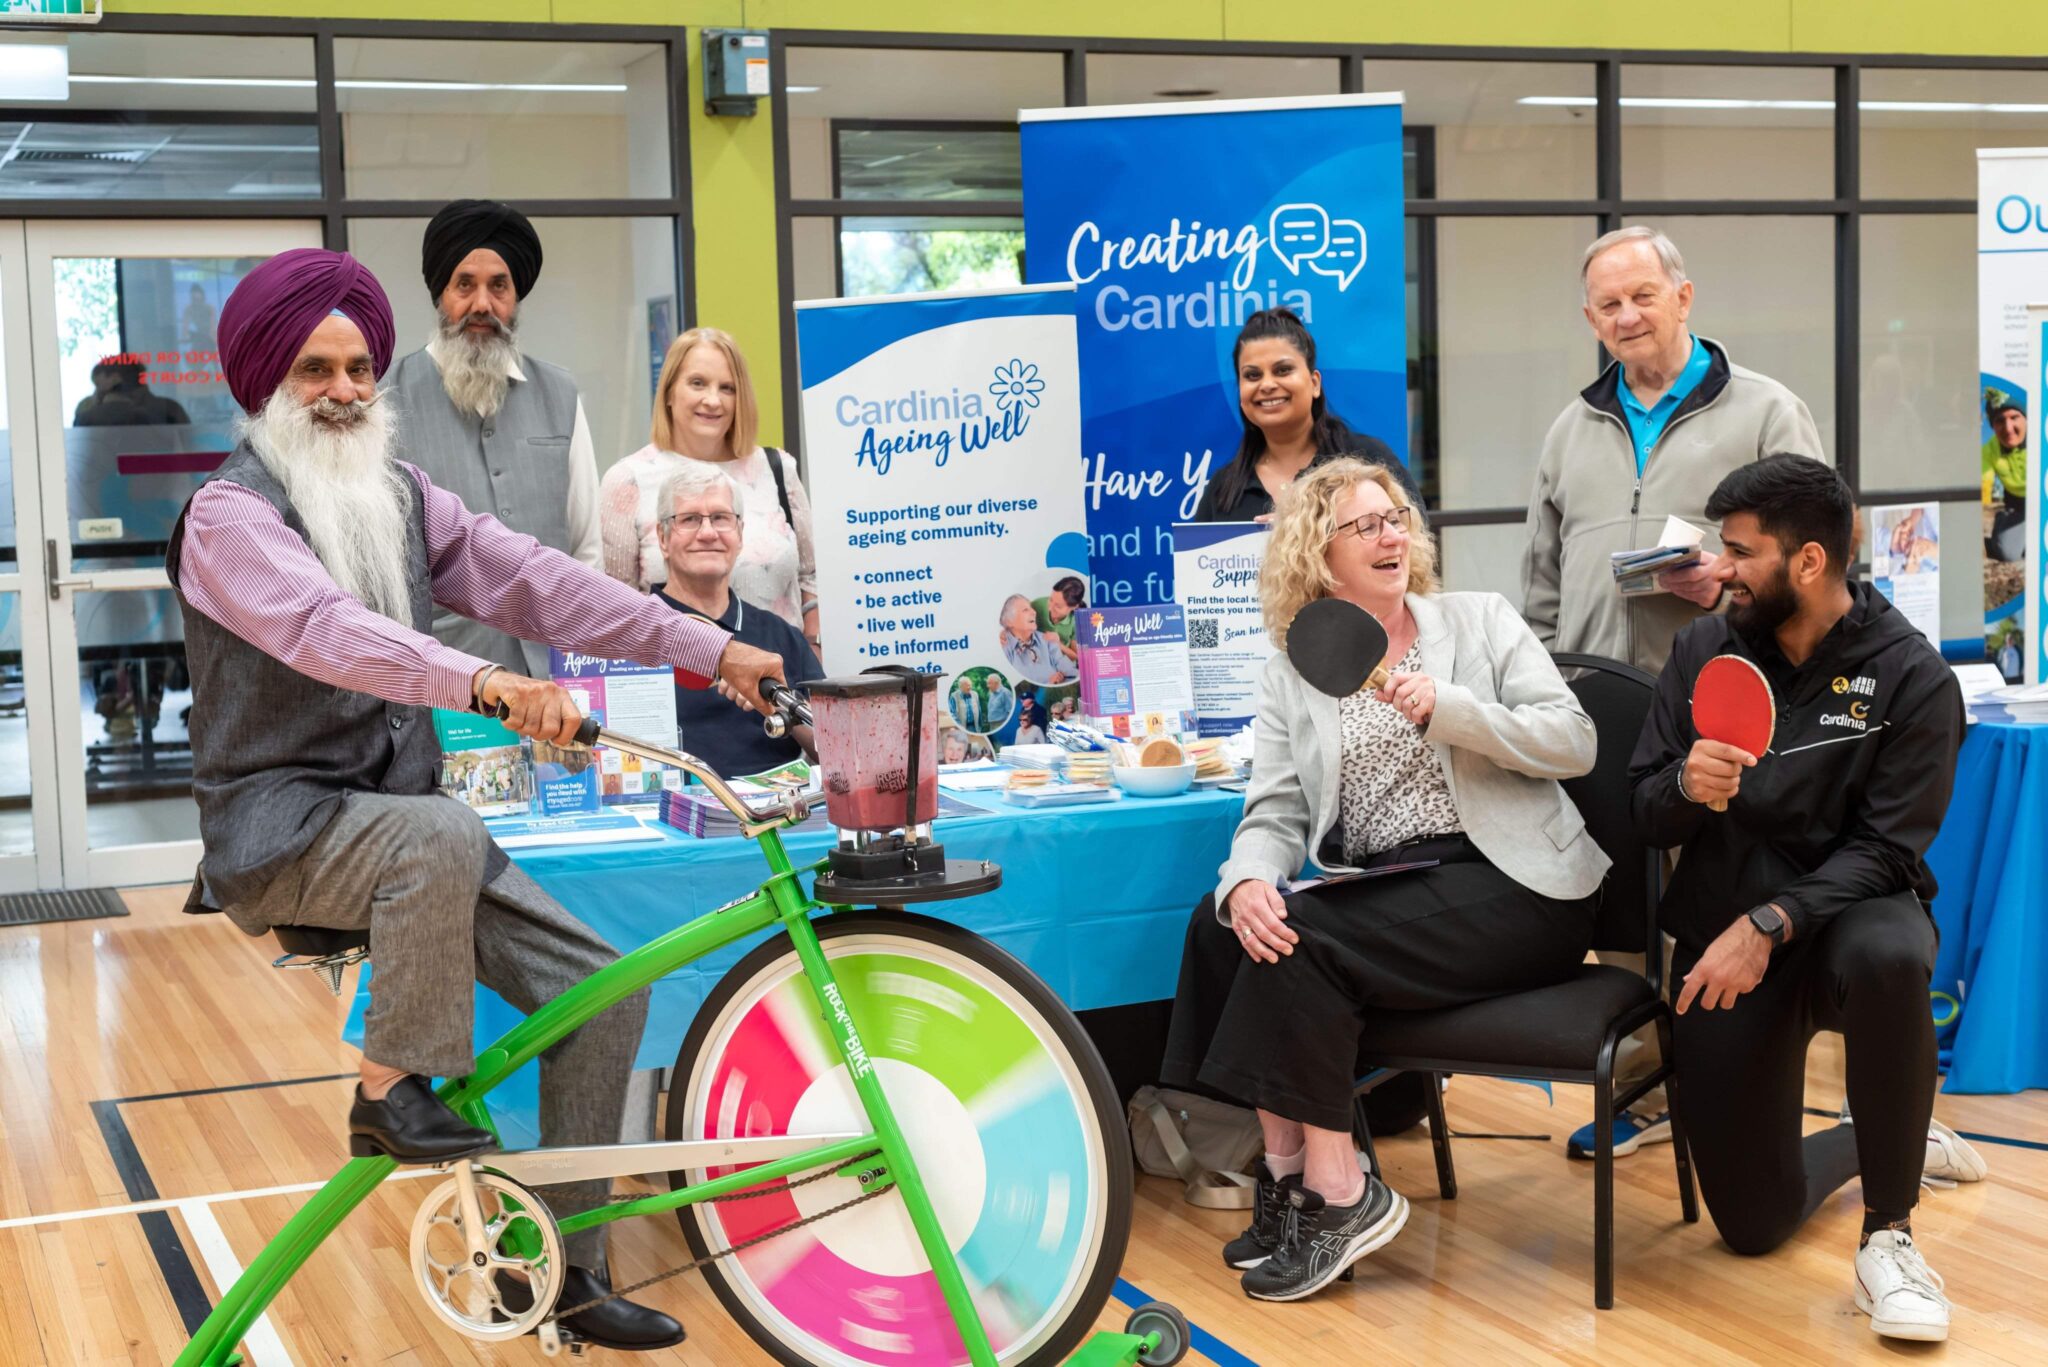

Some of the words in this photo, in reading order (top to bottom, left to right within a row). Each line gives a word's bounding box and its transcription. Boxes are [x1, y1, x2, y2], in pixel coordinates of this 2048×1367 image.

[1066, 217, 1268, 291] Creating
[835, 388, 984, 427] Cardinia
[855, 427, 955, 475] Ageing
[960, 400, 1030, 453] Well
[1081, 452, 1172, 510] Have
[1179, 449, 1213, 520] Y
[846, 504, 941, 526] Supporting
[945, 501, 972, 517] our
[977, 498, 1038, 515] diverse
[848, 526, 906, 547] ageing
[911, 522, 1009, 543] community.
[1087, 526, 1140, 557] and
[1156, 525, 1174, 556] h
[1198, 554, 1264, 570] Cardinia
[864, 565, 933, 585] connect
[1212, 569, 1260, 588] Suppo
[1091, 574, 1132, 604] he
[1144, 572, 1175, 604] fu
[865, 593, 886, 609] be
[891, 591, 942, 607] active
[1187, 596, 1207, 605] Find
[1209, 596, 1224, 604] the
[1227, 595, 1249, 603] local
[1187, 606, 1225, 615] services
[1225, 607, 1243, 616] you
[867, 617, 896, 633] live
[901, 614, 935, 631] well
[1094, 620, 1133, 646] Ageing
[1134, 613, 1164, 635] Well
[1224, 627, 1248, 642] Scan
[869, 642, 889, 657] be
[894, 636, 969, 656] informed
[916, 661, 942, 674] afe
[1820, 713, 1866, 730] Cardinia
[876, 769, 905, 784] ROCK
[889, 777, 908, 794] BIK
[823, 982, 846, 1024] ROCK
[842, 1017, 856, 1038] THE
[844, 1036, 872, 1078] BIKE
